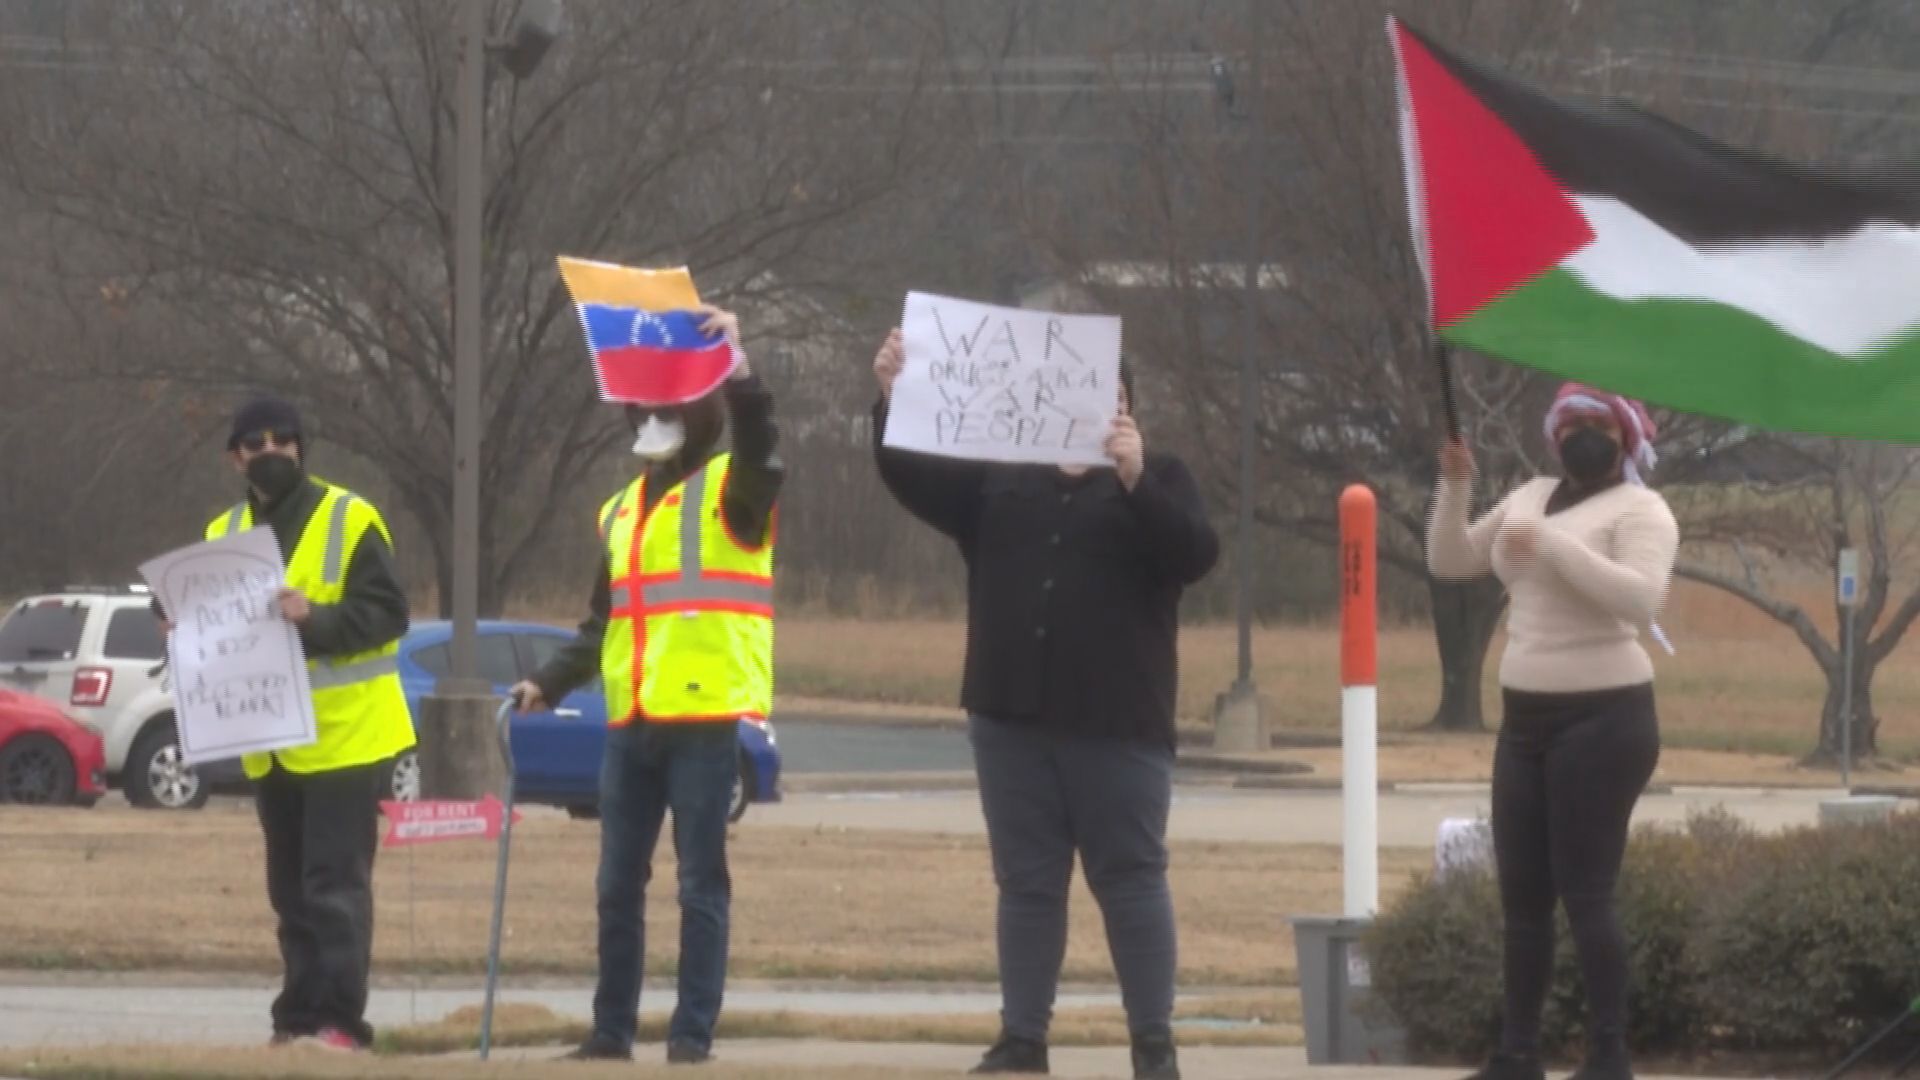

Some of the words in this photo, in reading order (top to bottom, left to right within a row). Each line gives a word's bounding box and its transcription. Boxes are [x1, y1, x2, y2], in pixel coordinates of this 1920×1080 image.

[931, 306, 1085, 364] WAR
[937, 381, 1071, 417] WAR
[935, 409, 1099, 449] PEOPLE
[403, 806, 433, 820] FOR
[437, 802, 477, 817] RENT
